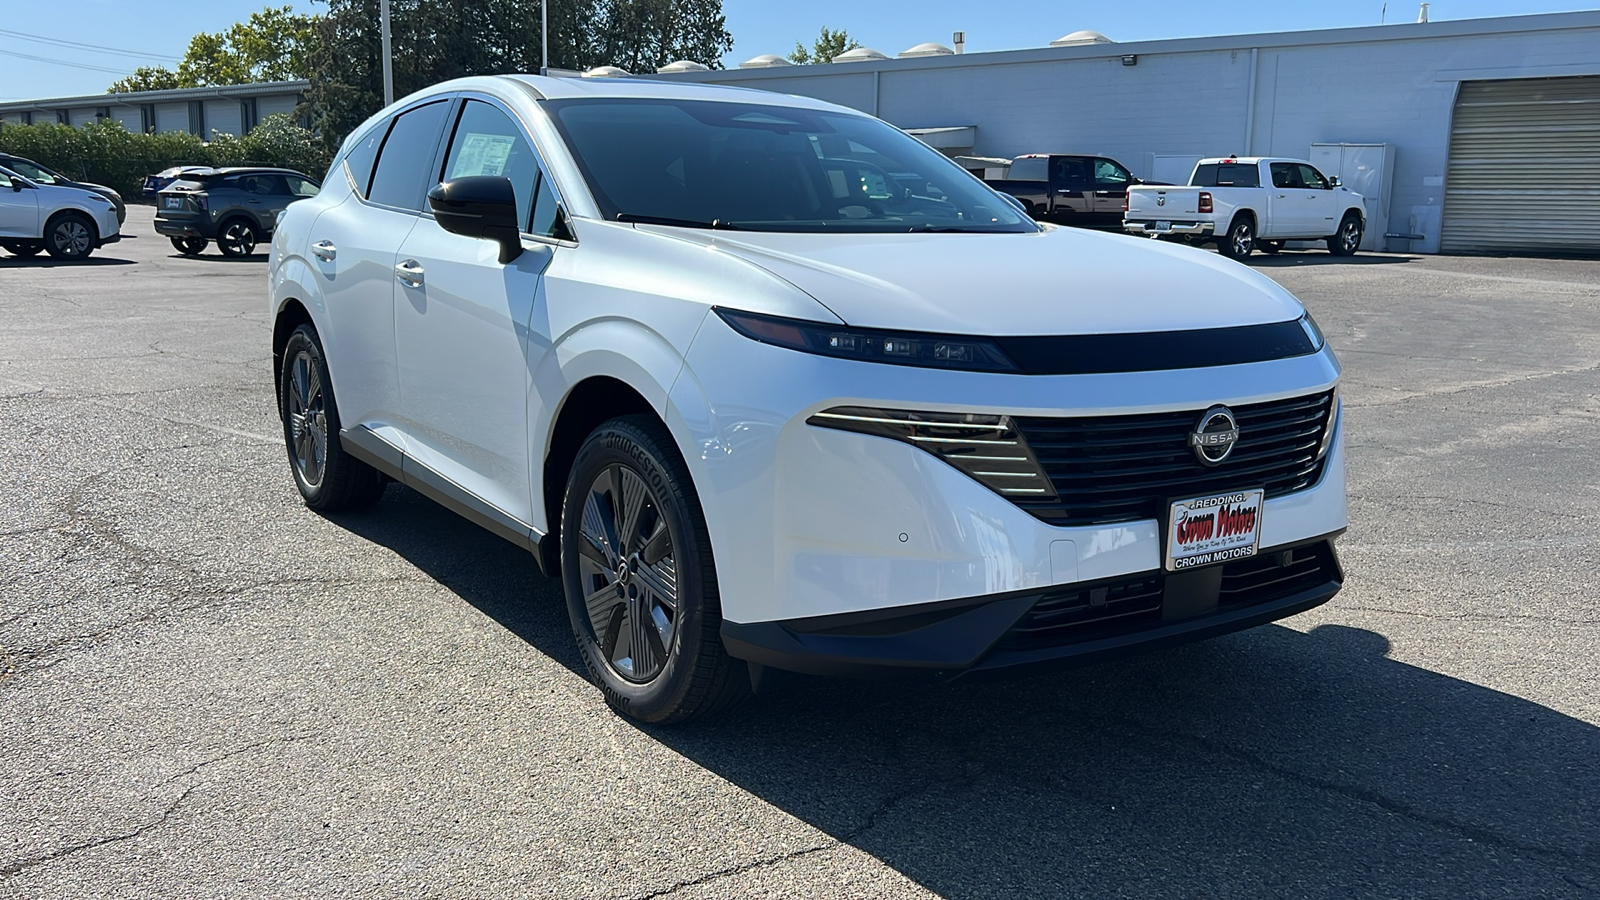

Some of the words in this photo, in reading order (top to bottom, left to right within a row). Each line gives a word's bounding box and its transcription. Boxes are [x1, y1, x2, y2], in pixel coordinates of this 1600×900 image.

[1194, 431, 1239, 444] NISSAN
[606, 431, 673, 511] BRIDGESTONE
[1196, 494, 1244, 509] REDDING
[1176, 510, 1215, 545] Crown
[1216, 504, 1257, 538] Motors
[1175, 553, 1212, 569] CROWN
[1213, 546, 1253, 561] MOTORS
